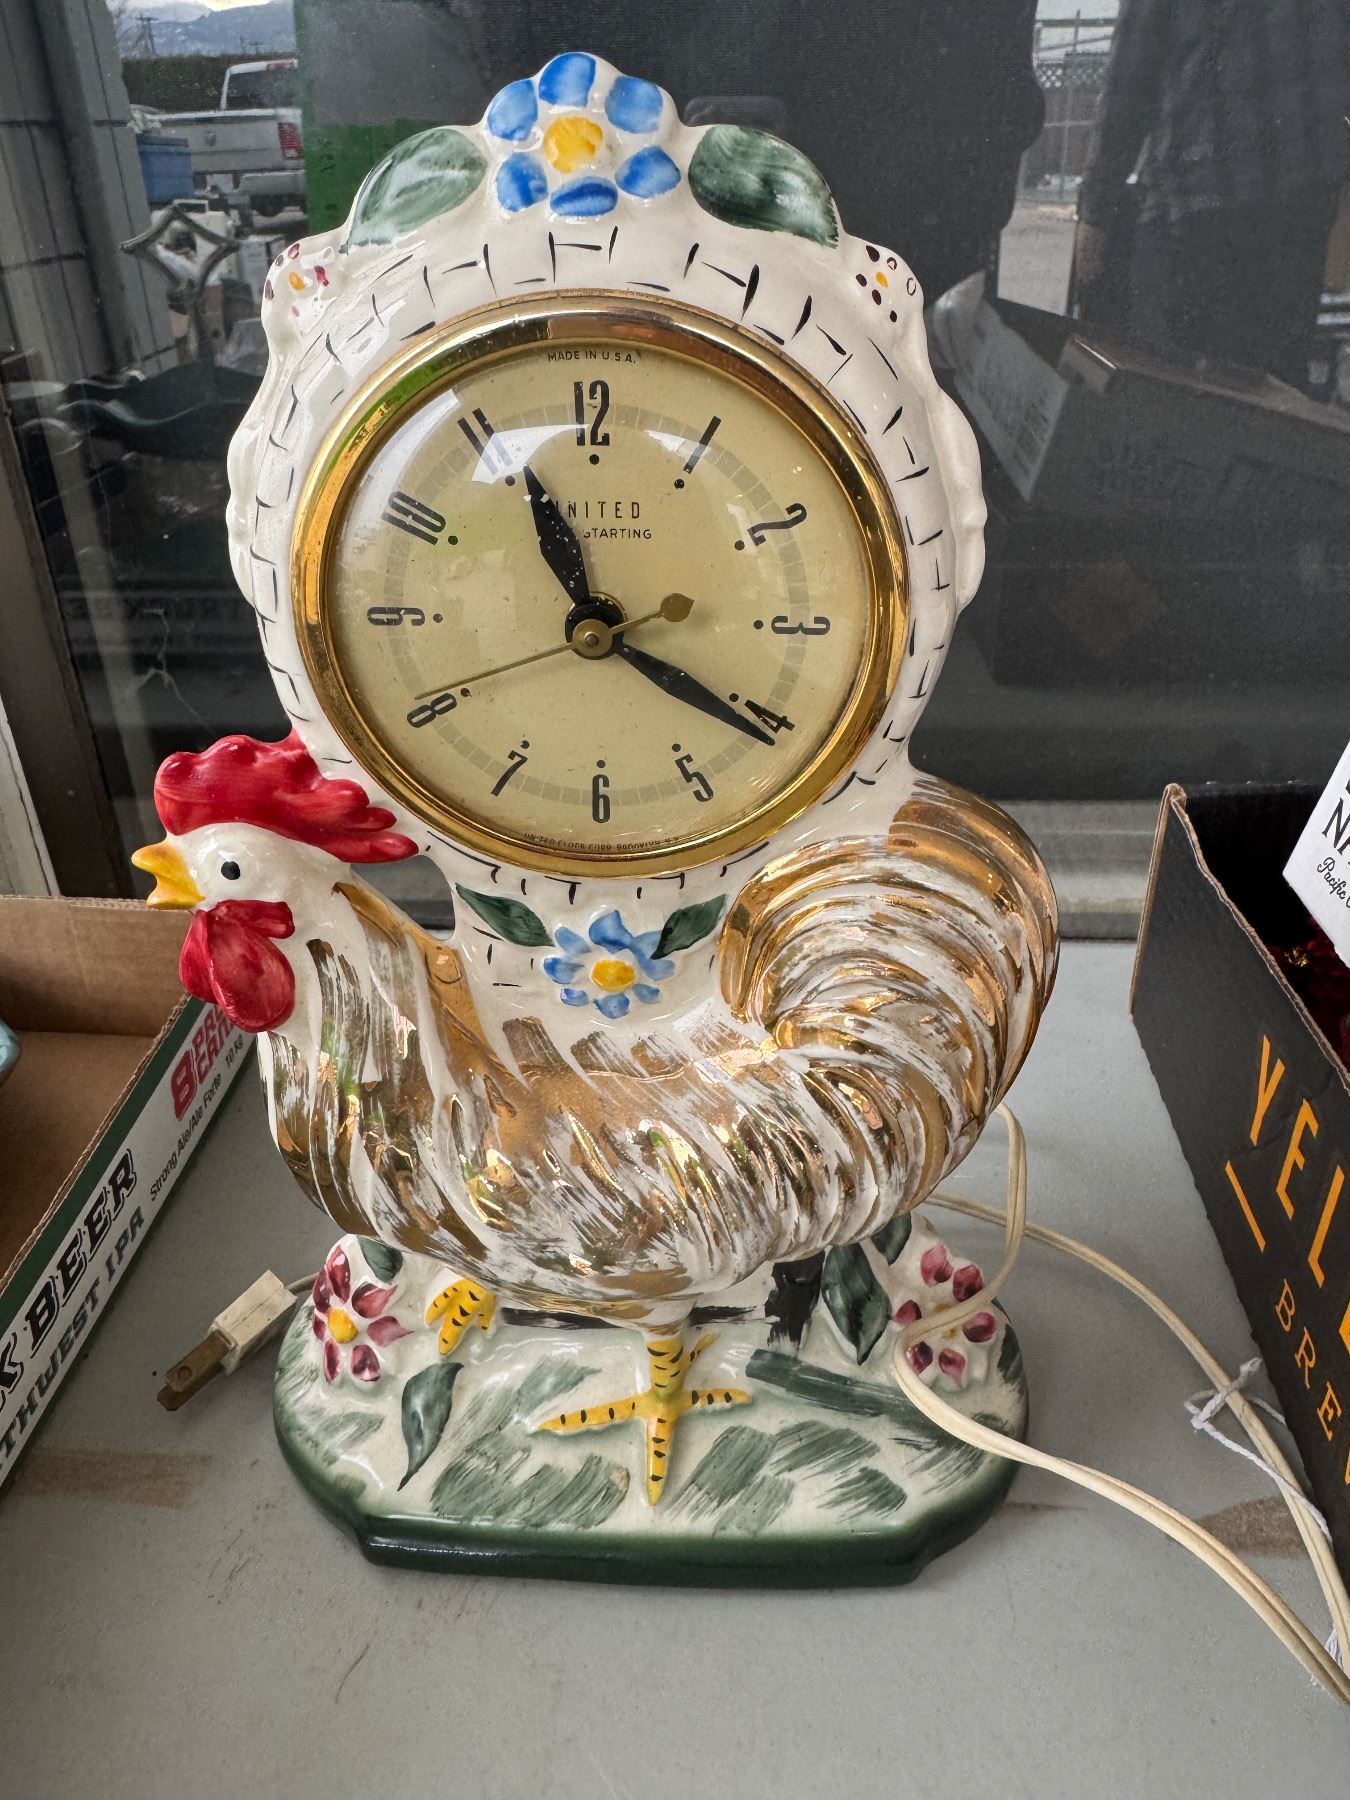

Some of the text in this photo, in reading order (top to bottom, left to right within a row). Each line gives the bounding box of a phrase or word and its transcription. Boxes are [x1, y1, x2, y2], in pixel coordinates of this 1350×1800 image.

[547, 350, 580, 362] MADE
[585, 350, 597, 360] IN
[574, 379, 610, 446] 12
[457, 407, 514, 475] 11
[683, 416, 722, 475] 1
[381, 490, 447, 546] 10
[583, 527, 652, 540] STARTING
[748, 502, 808, 547] 2
[366, 606, 426, 627] 9
[770, 615, 831, 636] 3
[406, 692, 457, 729] 8
[745, 699, 795, 733] 4
[490, 750, 529, 797] 7
[675, 753, 714, 802] 5
[591, 773, 611, 824] 6
[1317, 857, 1347, 900] Pacific
[150, 1151, 178, 1202] Strong
[177, 1103, 204, 1157] Ale/Ale
[24, 1148, 137, 1359] BEER
[0, 1206, 145, 1470] THWEST IPA
[1275, 1278, 1350, 1485] BRE
